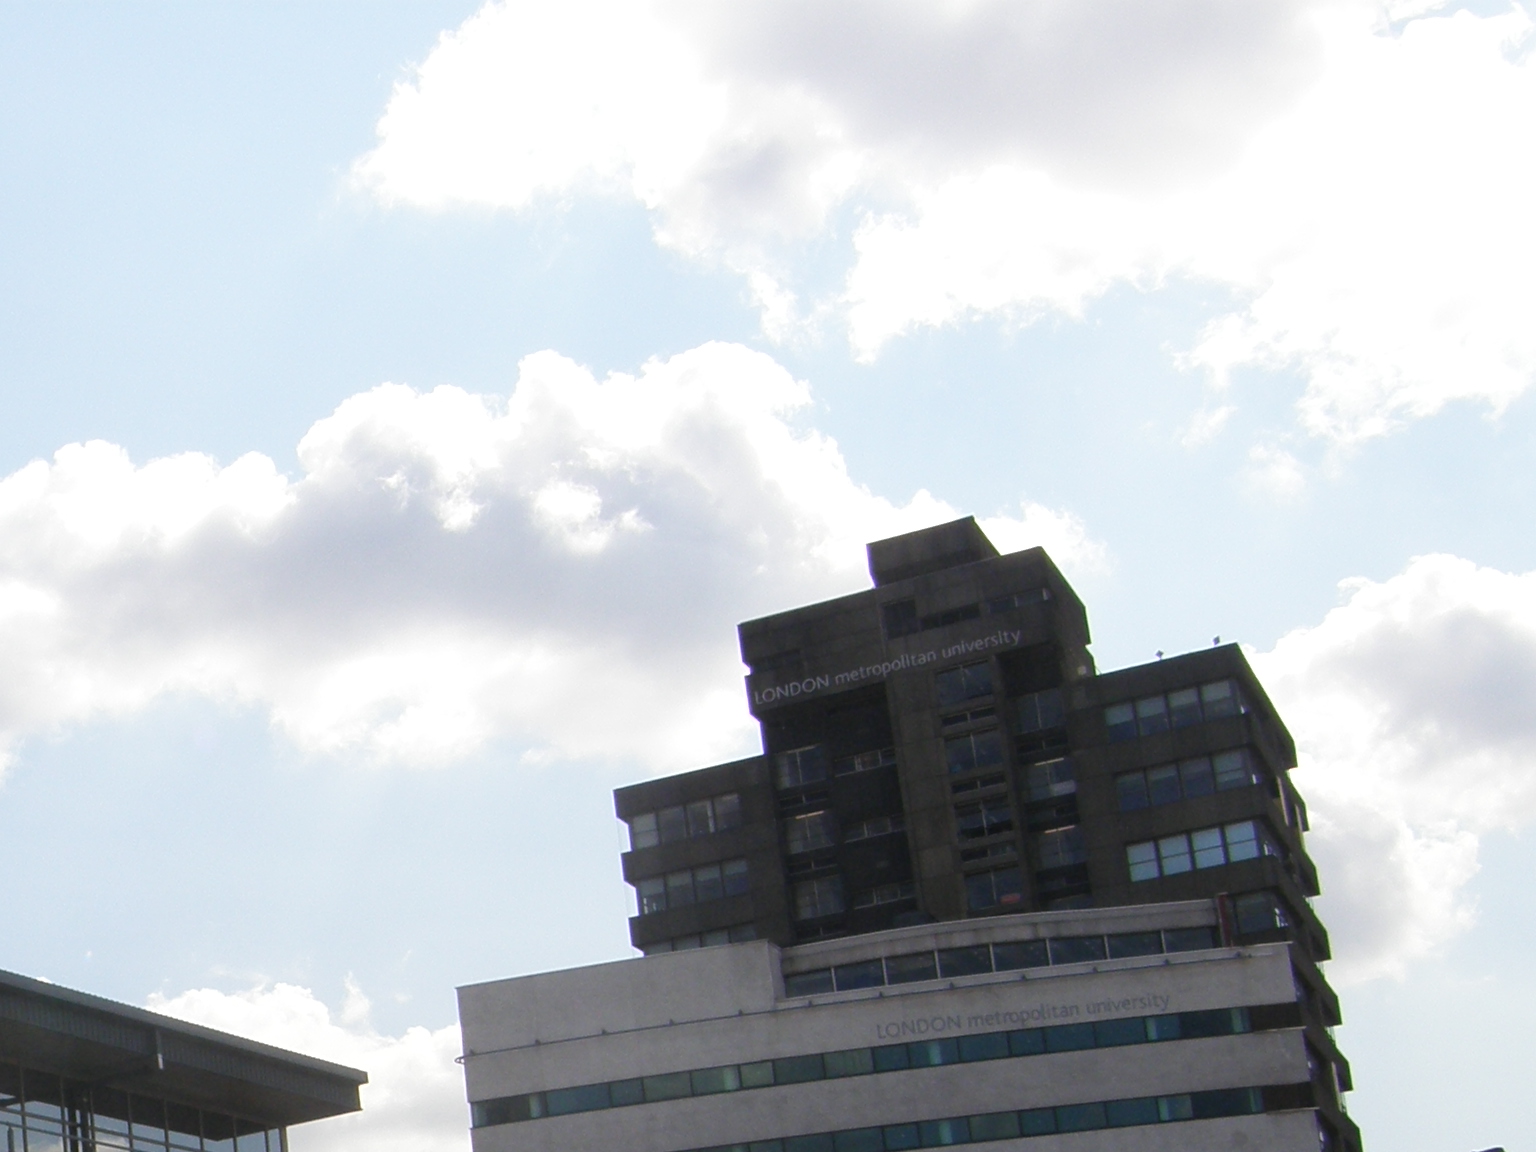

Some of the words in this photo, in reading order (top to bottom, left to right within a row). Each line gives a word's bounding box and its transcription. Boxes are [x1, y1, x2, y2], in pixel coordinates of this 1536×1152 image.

[754, 674, 830, 706] LONDON
[834, 651, 938, 687] metropolitan
[941, 629, 1023, 661] university
[876, 1014, 962, 1040] LONDON
[966, 999, 1080, 1030] metropolitan
[1086, 993, 1171, 1016] university
